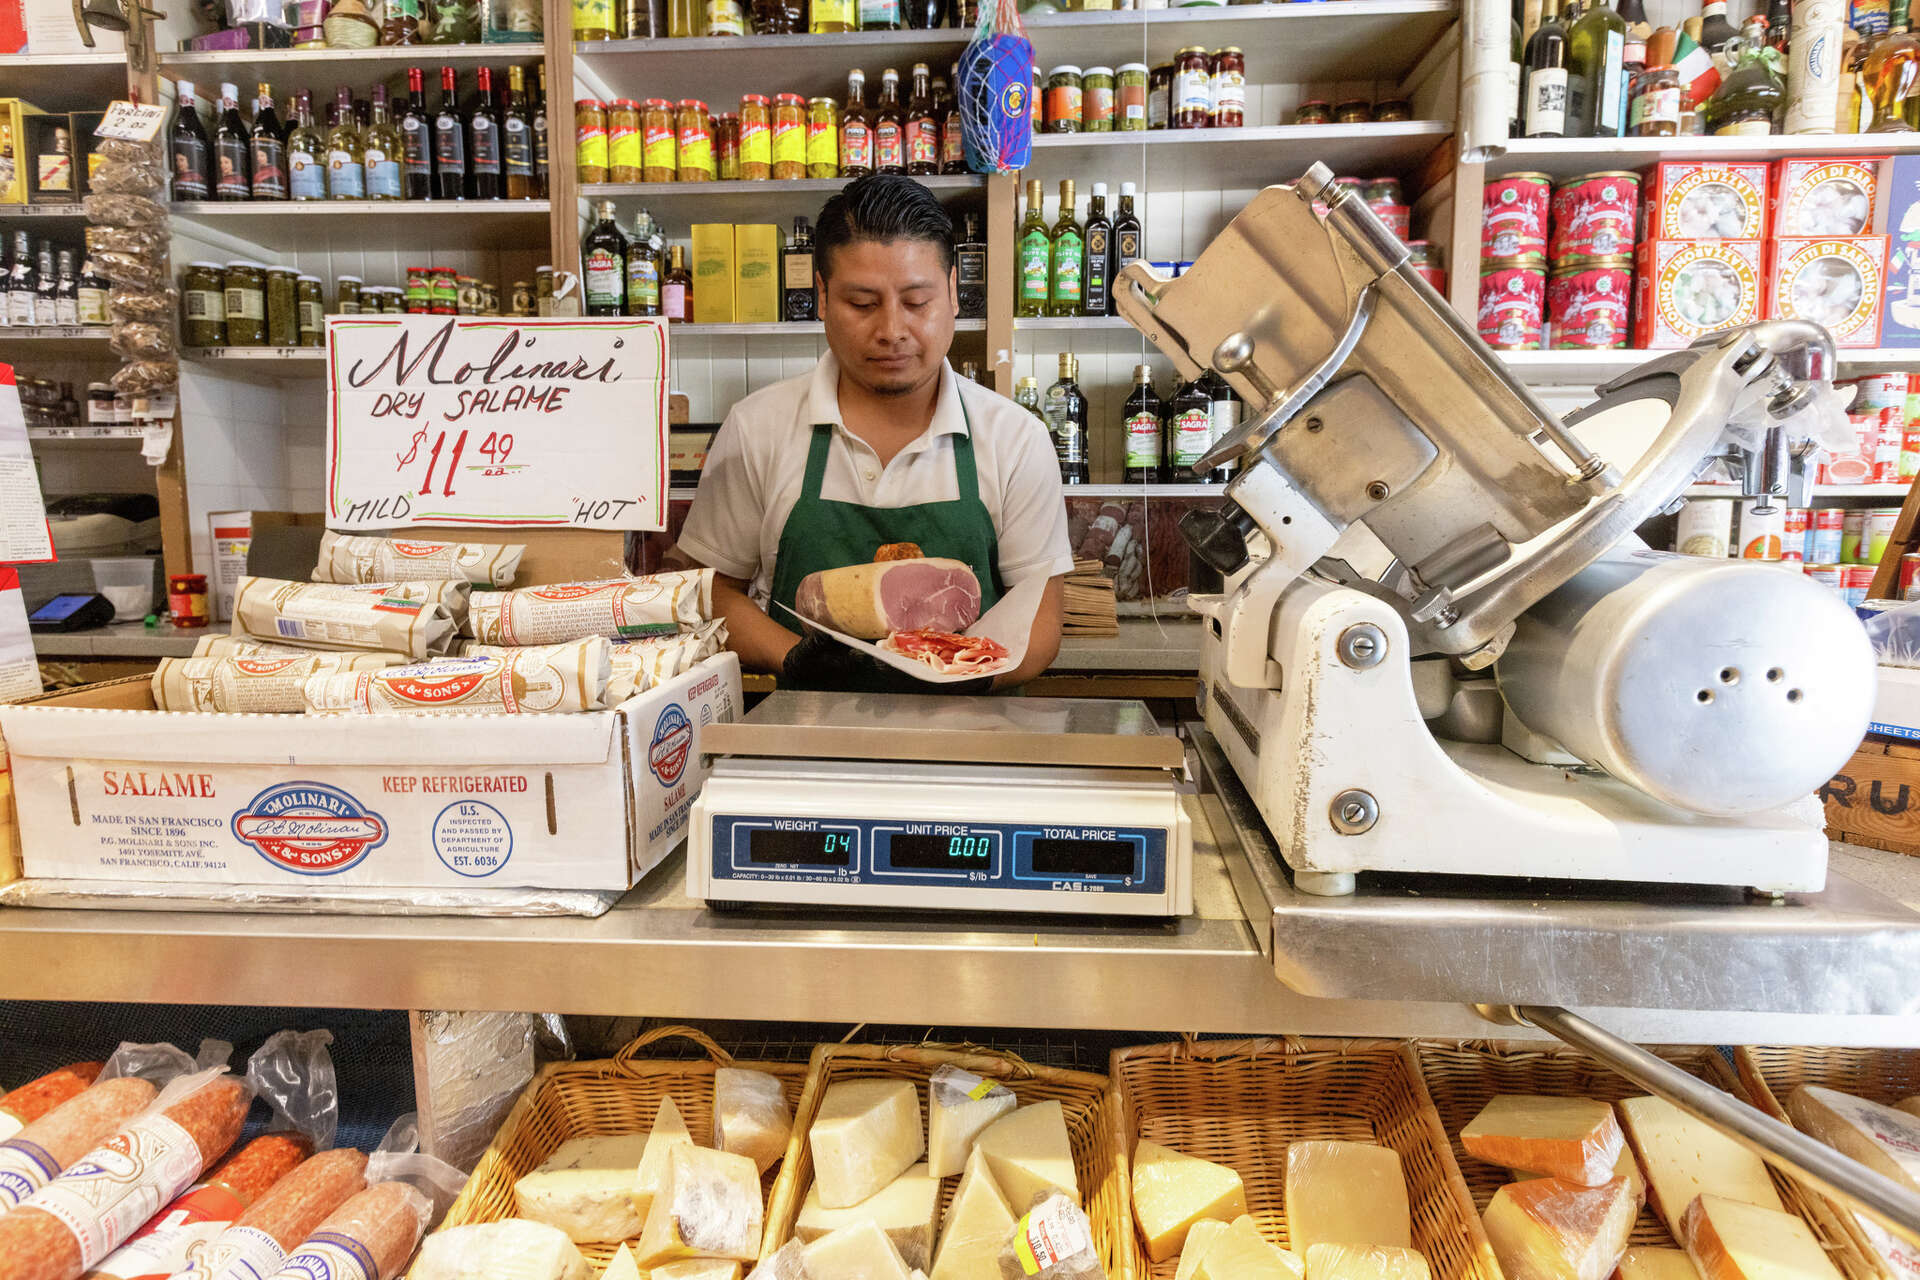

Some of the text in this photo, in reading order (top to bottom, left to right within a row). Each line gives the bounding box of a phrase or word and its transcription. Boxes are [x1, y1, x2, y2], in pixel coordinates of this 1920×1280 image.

[1821, 244, 1836, 255] DI
[349, 318, 625, 388] Molinari
[371, 385, 571, 421] DRY SALAME
[1181, 421, 1208, 429] SAGRA
[406, 681, 462, 698] & SONS
[103, 770, 216, 798] SALAME
[382, 776, 528, 793] KEEP REFRIGERATED
[263, 792, 347, 816] MOLINARI
[460, 805, 480, 816] U.S.
[91, 814, 224, 828] MADE IN SAN FRANCISCO
[774, 820, 819, 831] WEIGHT
[130, 826, 186, 837] SINCE 1896
[906, 824, 968, 837] UNIT PRICE
[1043, 828, 1117, 841] TOTAL PRICE
[118, 838, 163, 847] MOLINARI
[174, 839, 198, 848] SONS
[199, 840, 219, 849] INC.
[949, 837, 990, 857] 0.00
[137, 849, 185, 857] YOSEMITE
[281, 848, 344, 864] & SONS
[100, 857, 118, 866] SAN
[203, 861, 227, 869] 94124
[454, 856, 498, 866] EST. 6036
[838, 867, 848, 876] lb
[969, 871, 988, 881] $/lb
[1052, 881, 1083, 892] CAS
[1124, 876, 1132, 886] $
